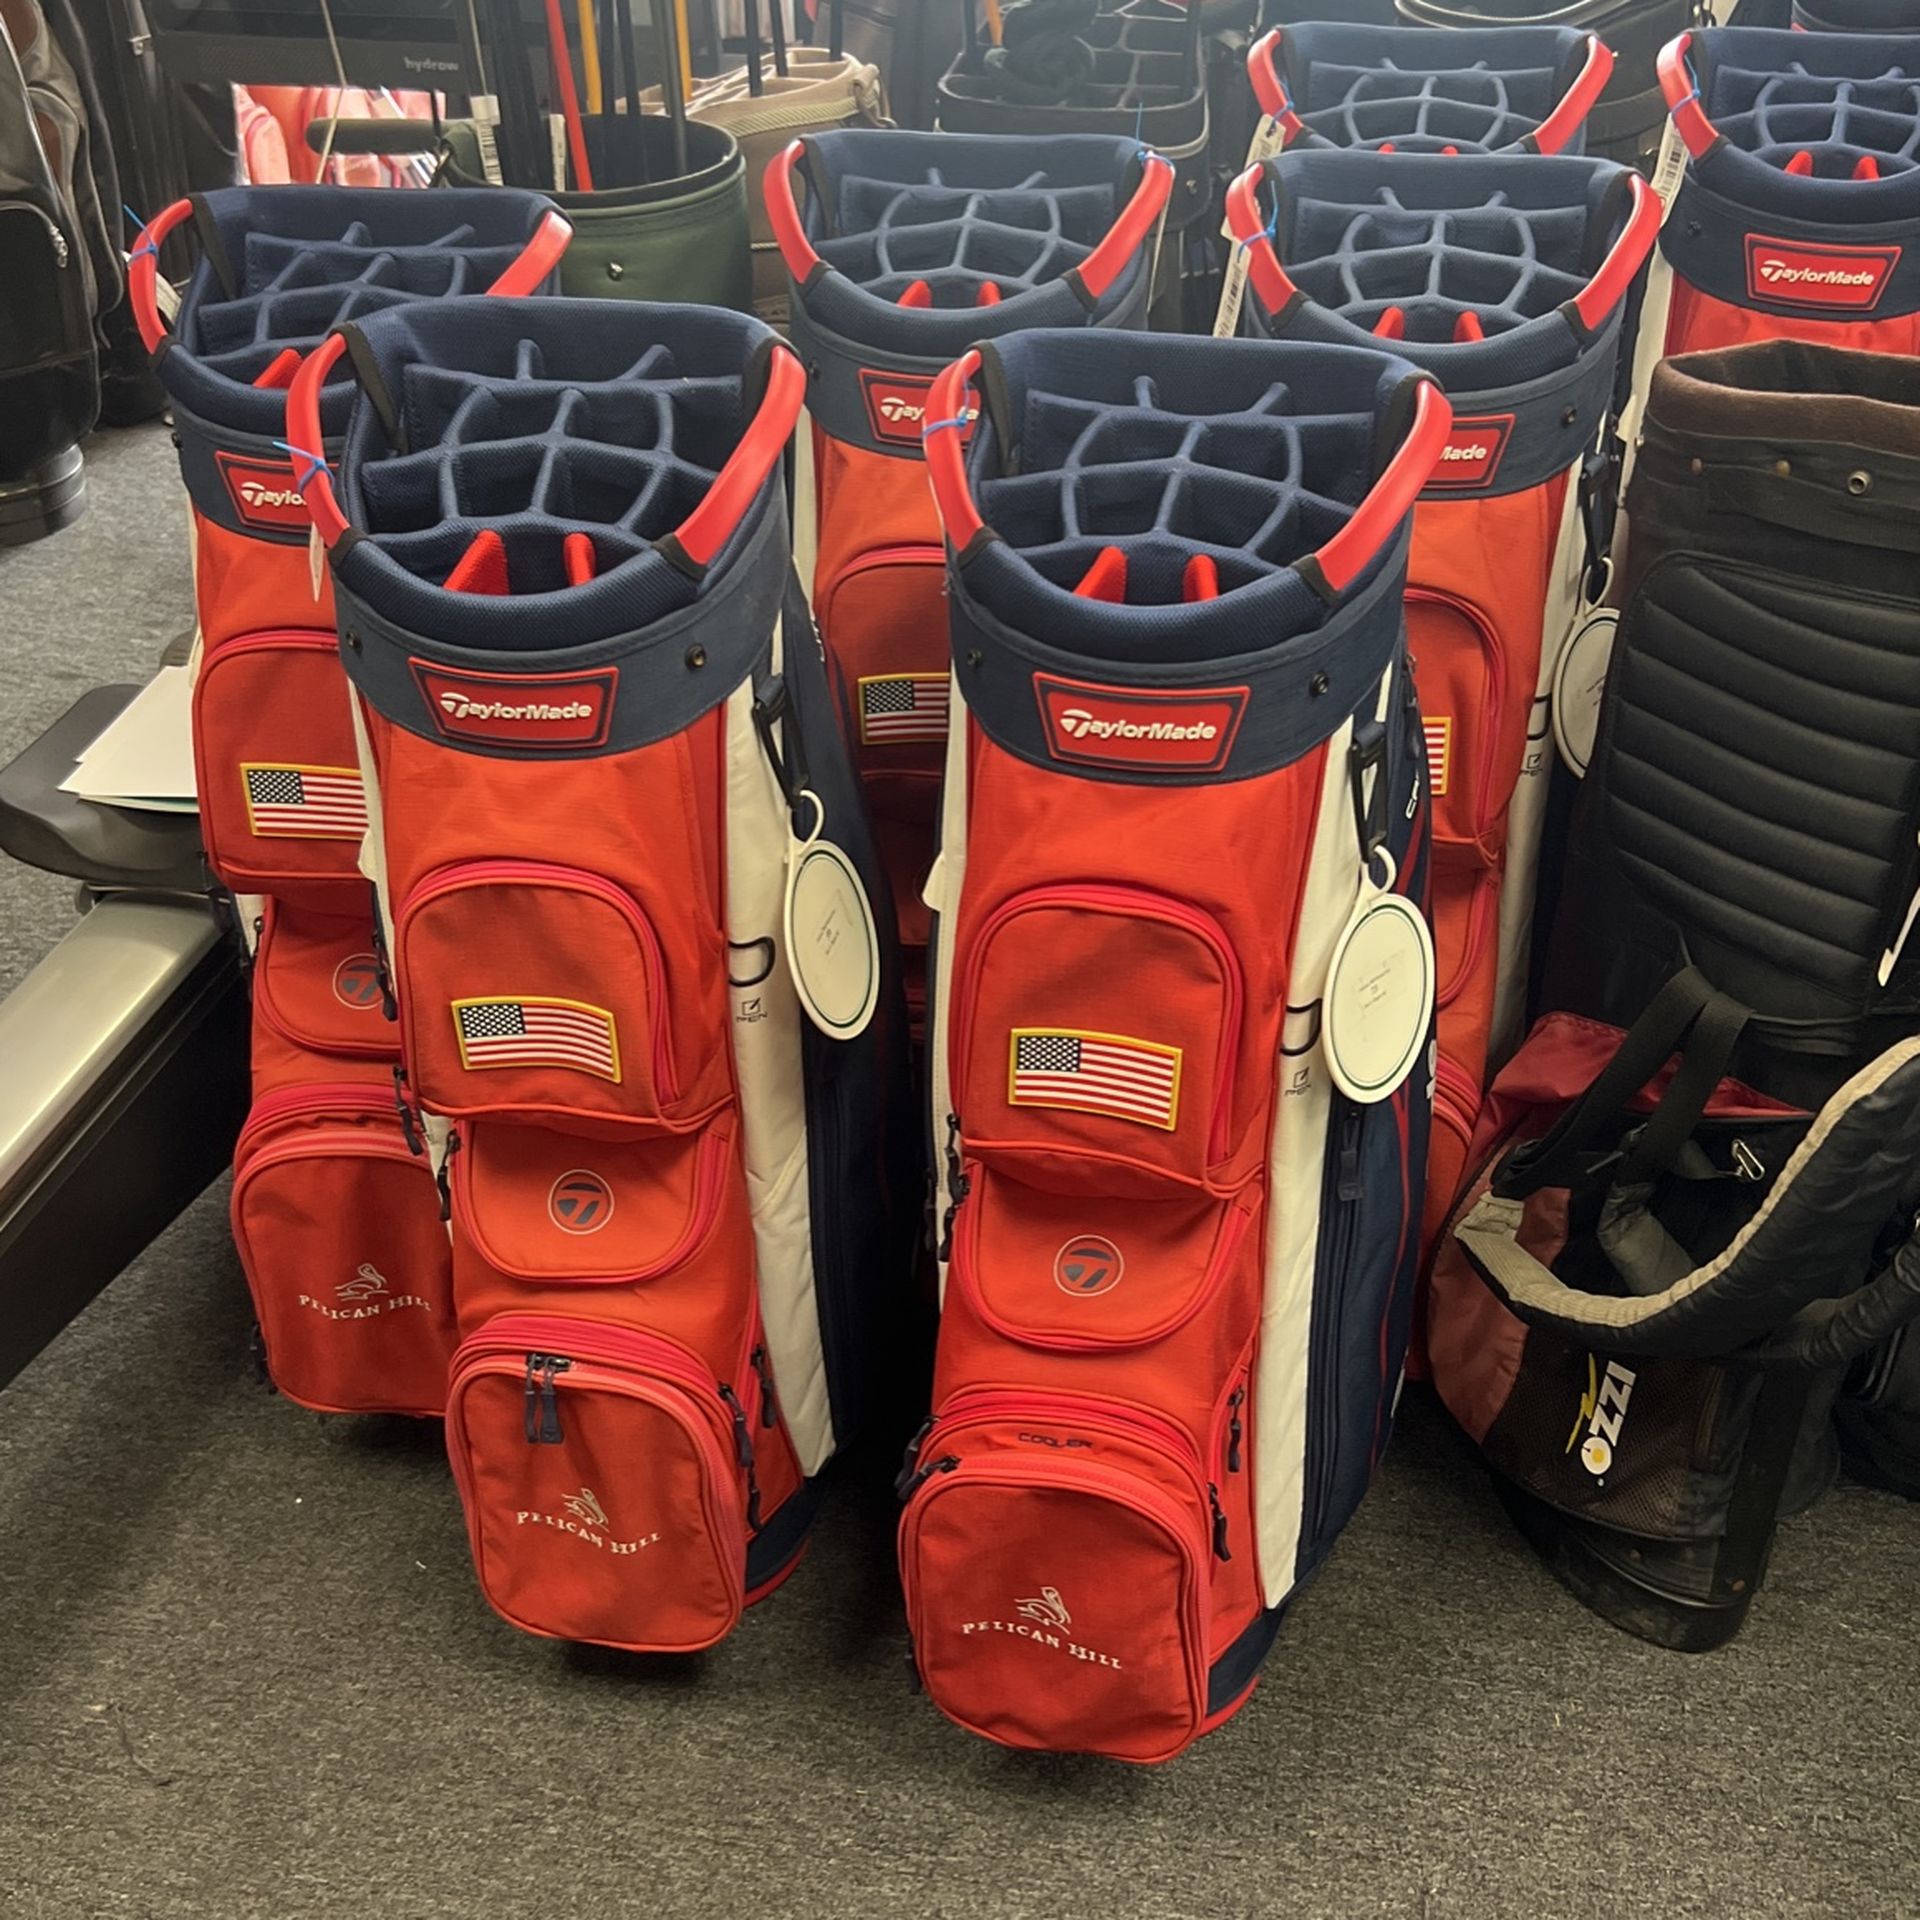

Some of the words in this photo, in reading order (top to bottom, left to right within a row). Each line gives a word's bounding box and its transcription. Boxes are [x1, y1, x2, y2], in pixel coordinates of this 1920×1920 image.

[403, 55, 459, 73] hydrow
[1760, 259, 1875, 286] TaylorMade
[440, 692, 593, 720] TaylorMade
[1060, 708, 1217, 740] TaylorMade
[299, 1294, 380, 1320] PELICAN
[389, 1295, 432, 1312] HILL
[1580, 1360, 1637, 1475] OZZI
[516, 1511, 603, 1548] PELICAN
[610, 1532, 661, 1554] HILL
[961, 1621, 1061, 1649] PELICAN
[1068, 1642, 1123, 1670] HILL
